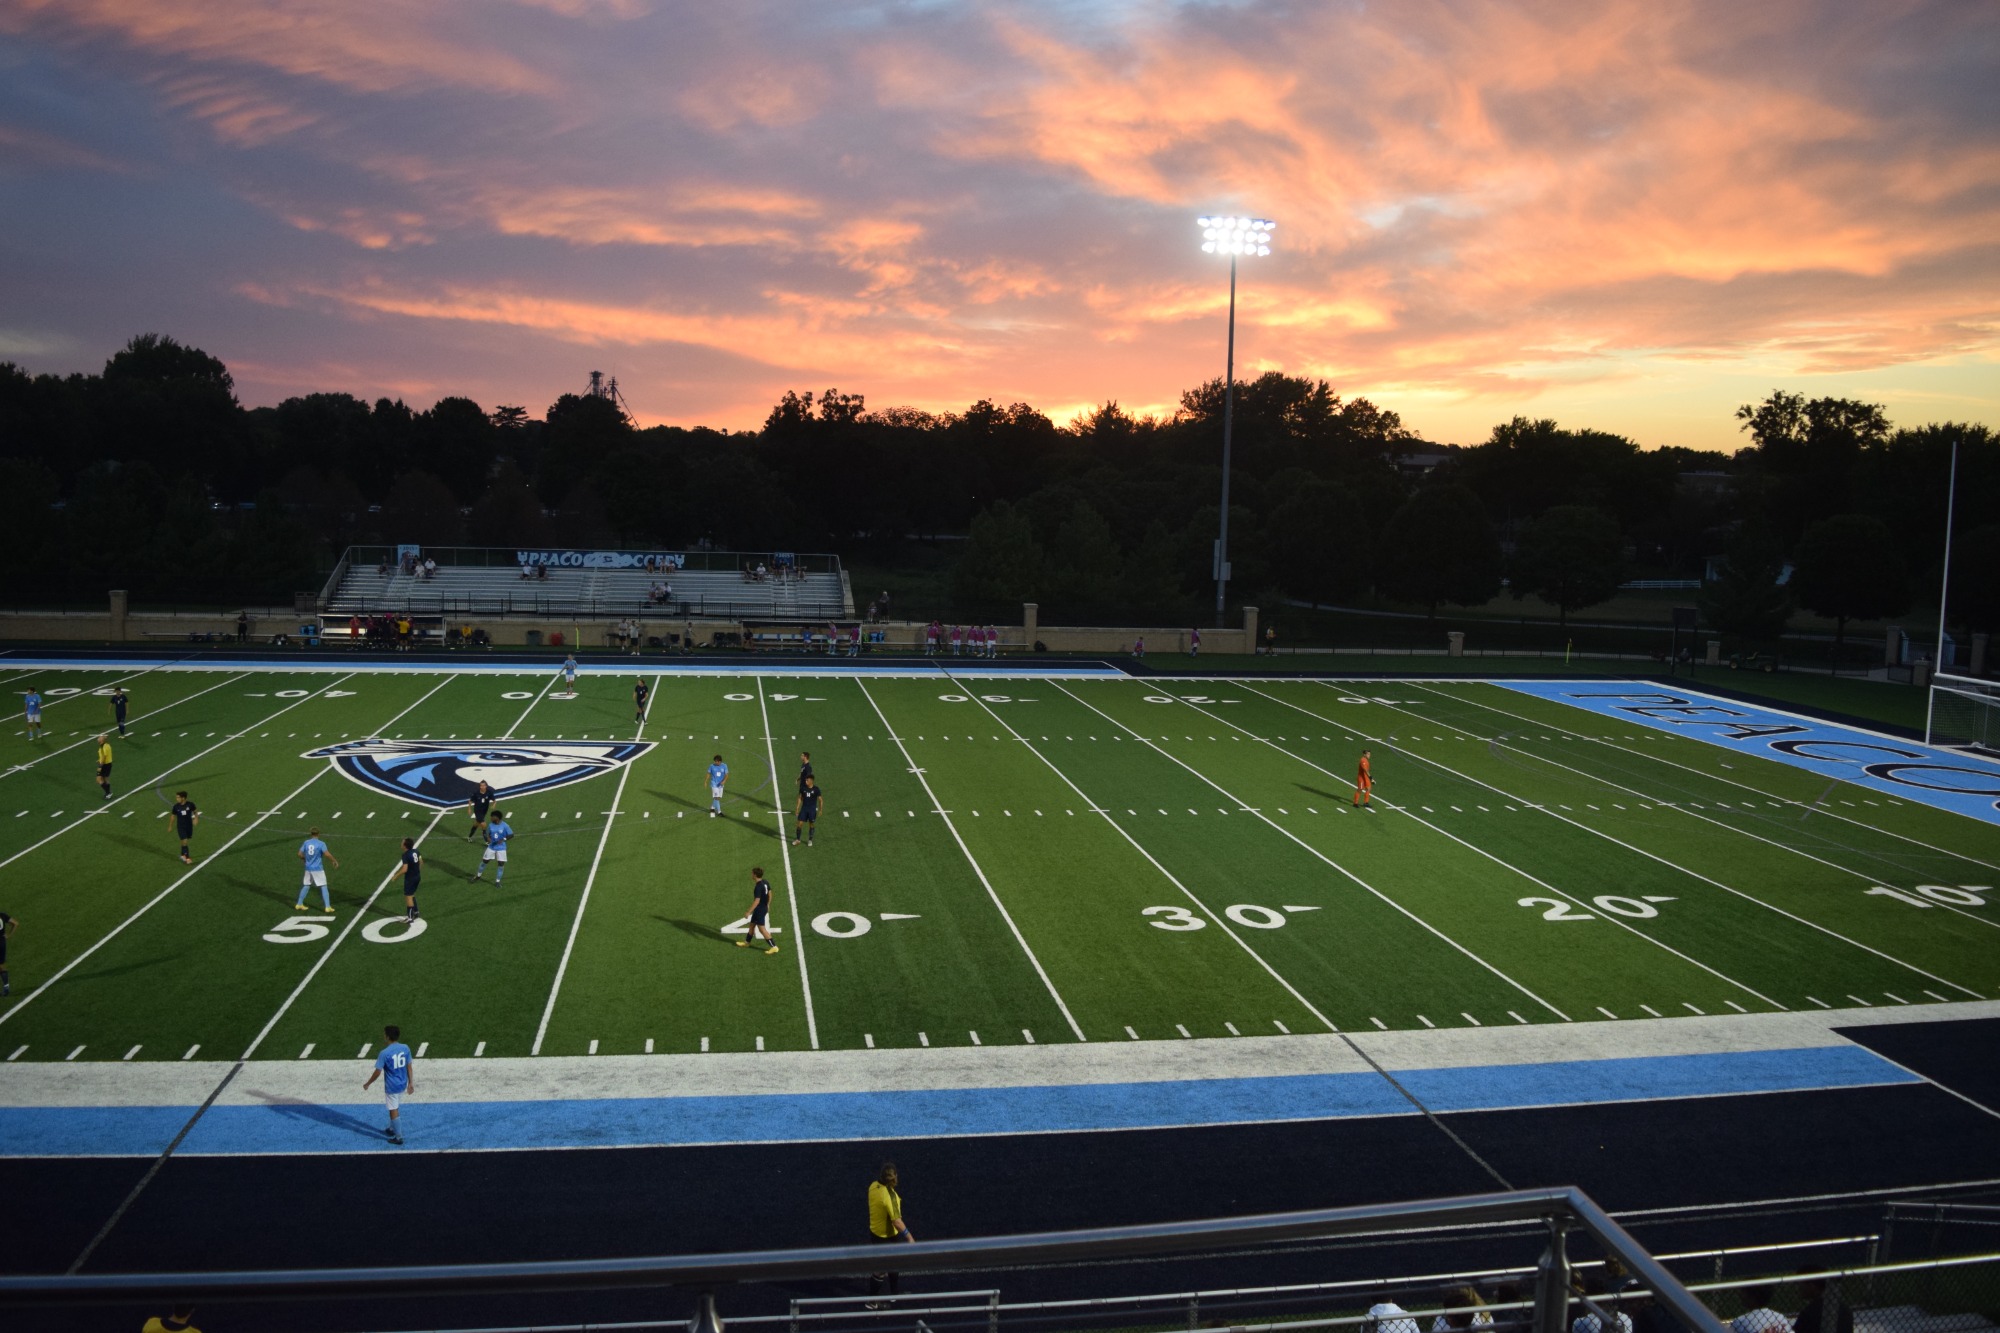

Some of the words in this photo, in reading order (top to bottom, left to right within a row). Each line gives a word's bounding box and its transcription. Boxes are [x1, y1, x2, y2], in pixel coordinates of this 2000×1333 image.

[1560, 693, 2000, 812] PEACO
[308, 844, 315, 856] 8
[412, 852, 419, 863] 8
[1141, 904, 1287, 931] 30
[1517, 895, 1659, 921] 20
[262, 915, 428, 943] 50
[392, 1051, 406, 1069] 16
